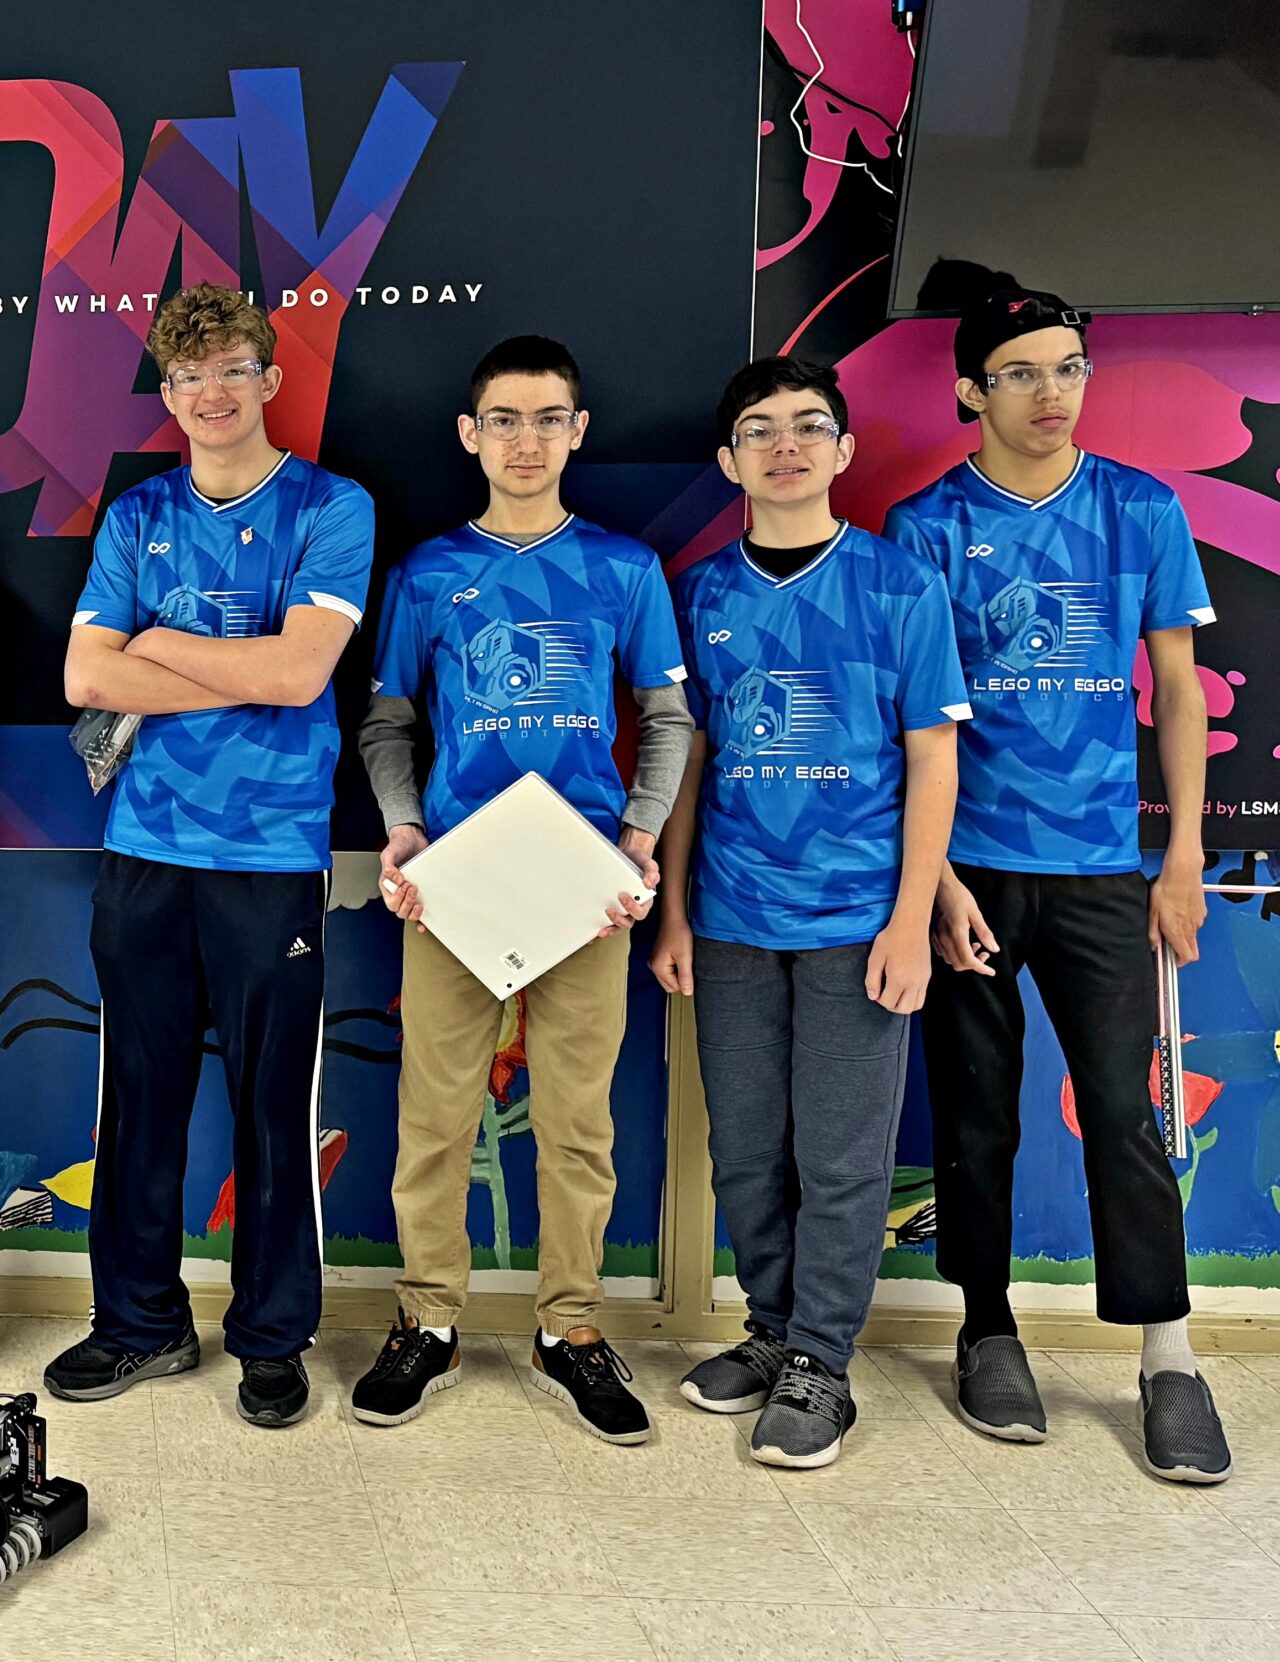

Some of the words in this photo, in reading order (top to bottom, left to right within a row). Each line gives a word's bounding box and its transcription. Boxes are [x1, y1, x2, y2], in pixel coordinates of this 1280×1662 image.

[54, 293, 159, 313] WHAT
[281, 288, 329, 308] DO
[356, 283, 484, 306] TODAY
[973, 677, 1031, 691] LEGO
[1038, 677, 1065, 691] MY
[1074, 677, 1125, 692] EGGO
[462, 717, 512, 735] LEGO
[519, 715, 545, 729] MY
[553, 714, 600, 729] EGGO
[761, 765, 787, 779] MY
[795, 765, 850, 779] EGGO
[1216, 800, 1238, 818] by
[1241, 800, 1280, 815] LSM
